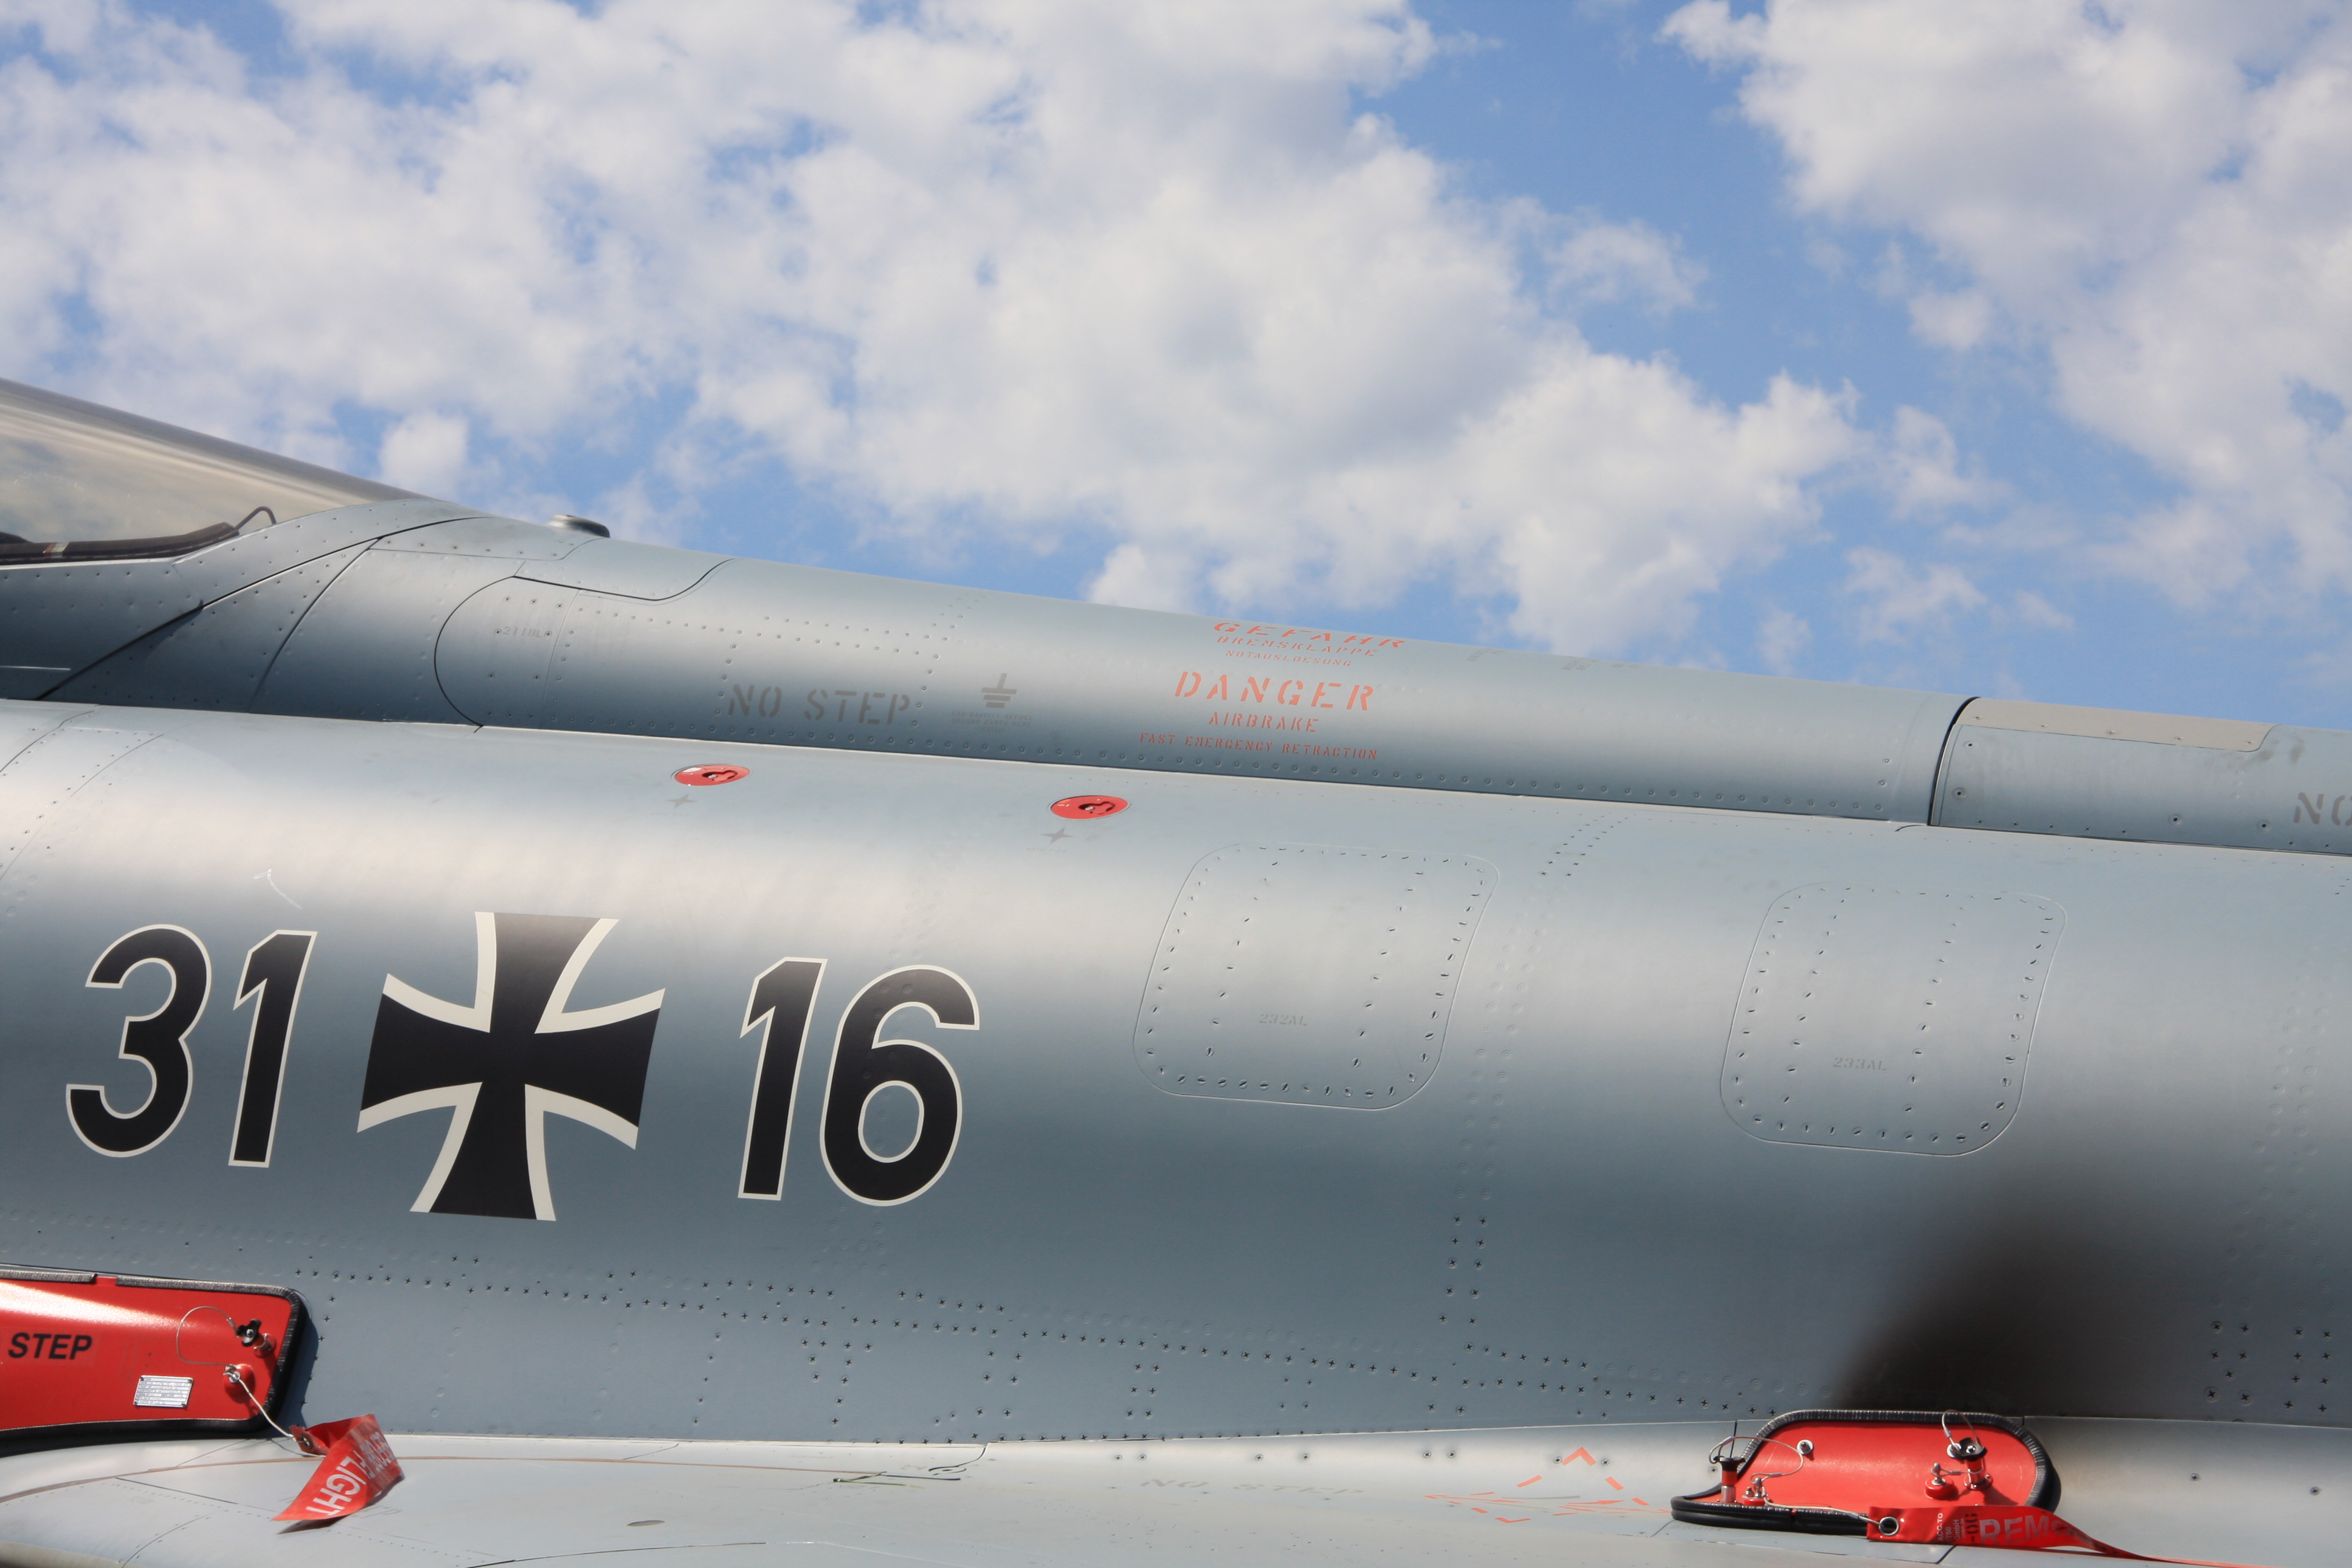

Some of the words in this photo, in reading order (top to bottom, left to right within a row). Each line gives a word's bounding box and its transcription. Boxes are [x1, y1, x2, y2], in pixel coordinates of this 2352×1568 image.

[1214, 622, 1405, 648] GEFAHR
[1216, 636, 1378, 656] BREMSKLAPPE
[1225, 650, 1353, 667] NOTAUSLOESUNG
[728, 684, 783, 718] NO
[804, 688, 911, 725] STEP
[1174, 671, 1374, 711] DANGER
[1208, 711, 1319, 733] AIRBRAKE
[1140, 733, 1176, 745] FAST
[1184, 736, 1273, 752] EMERGENCY
[1281, 743, 1379, 760] RETRACTION
[2293, 792, 2352, 827] NO
[65, 924, 318, 1168] 31
[737, 956, 980, 1207] 16
[8, 1332, 93, 1360] STEP
[305, 1449, 375, 1516] FLIGHT
